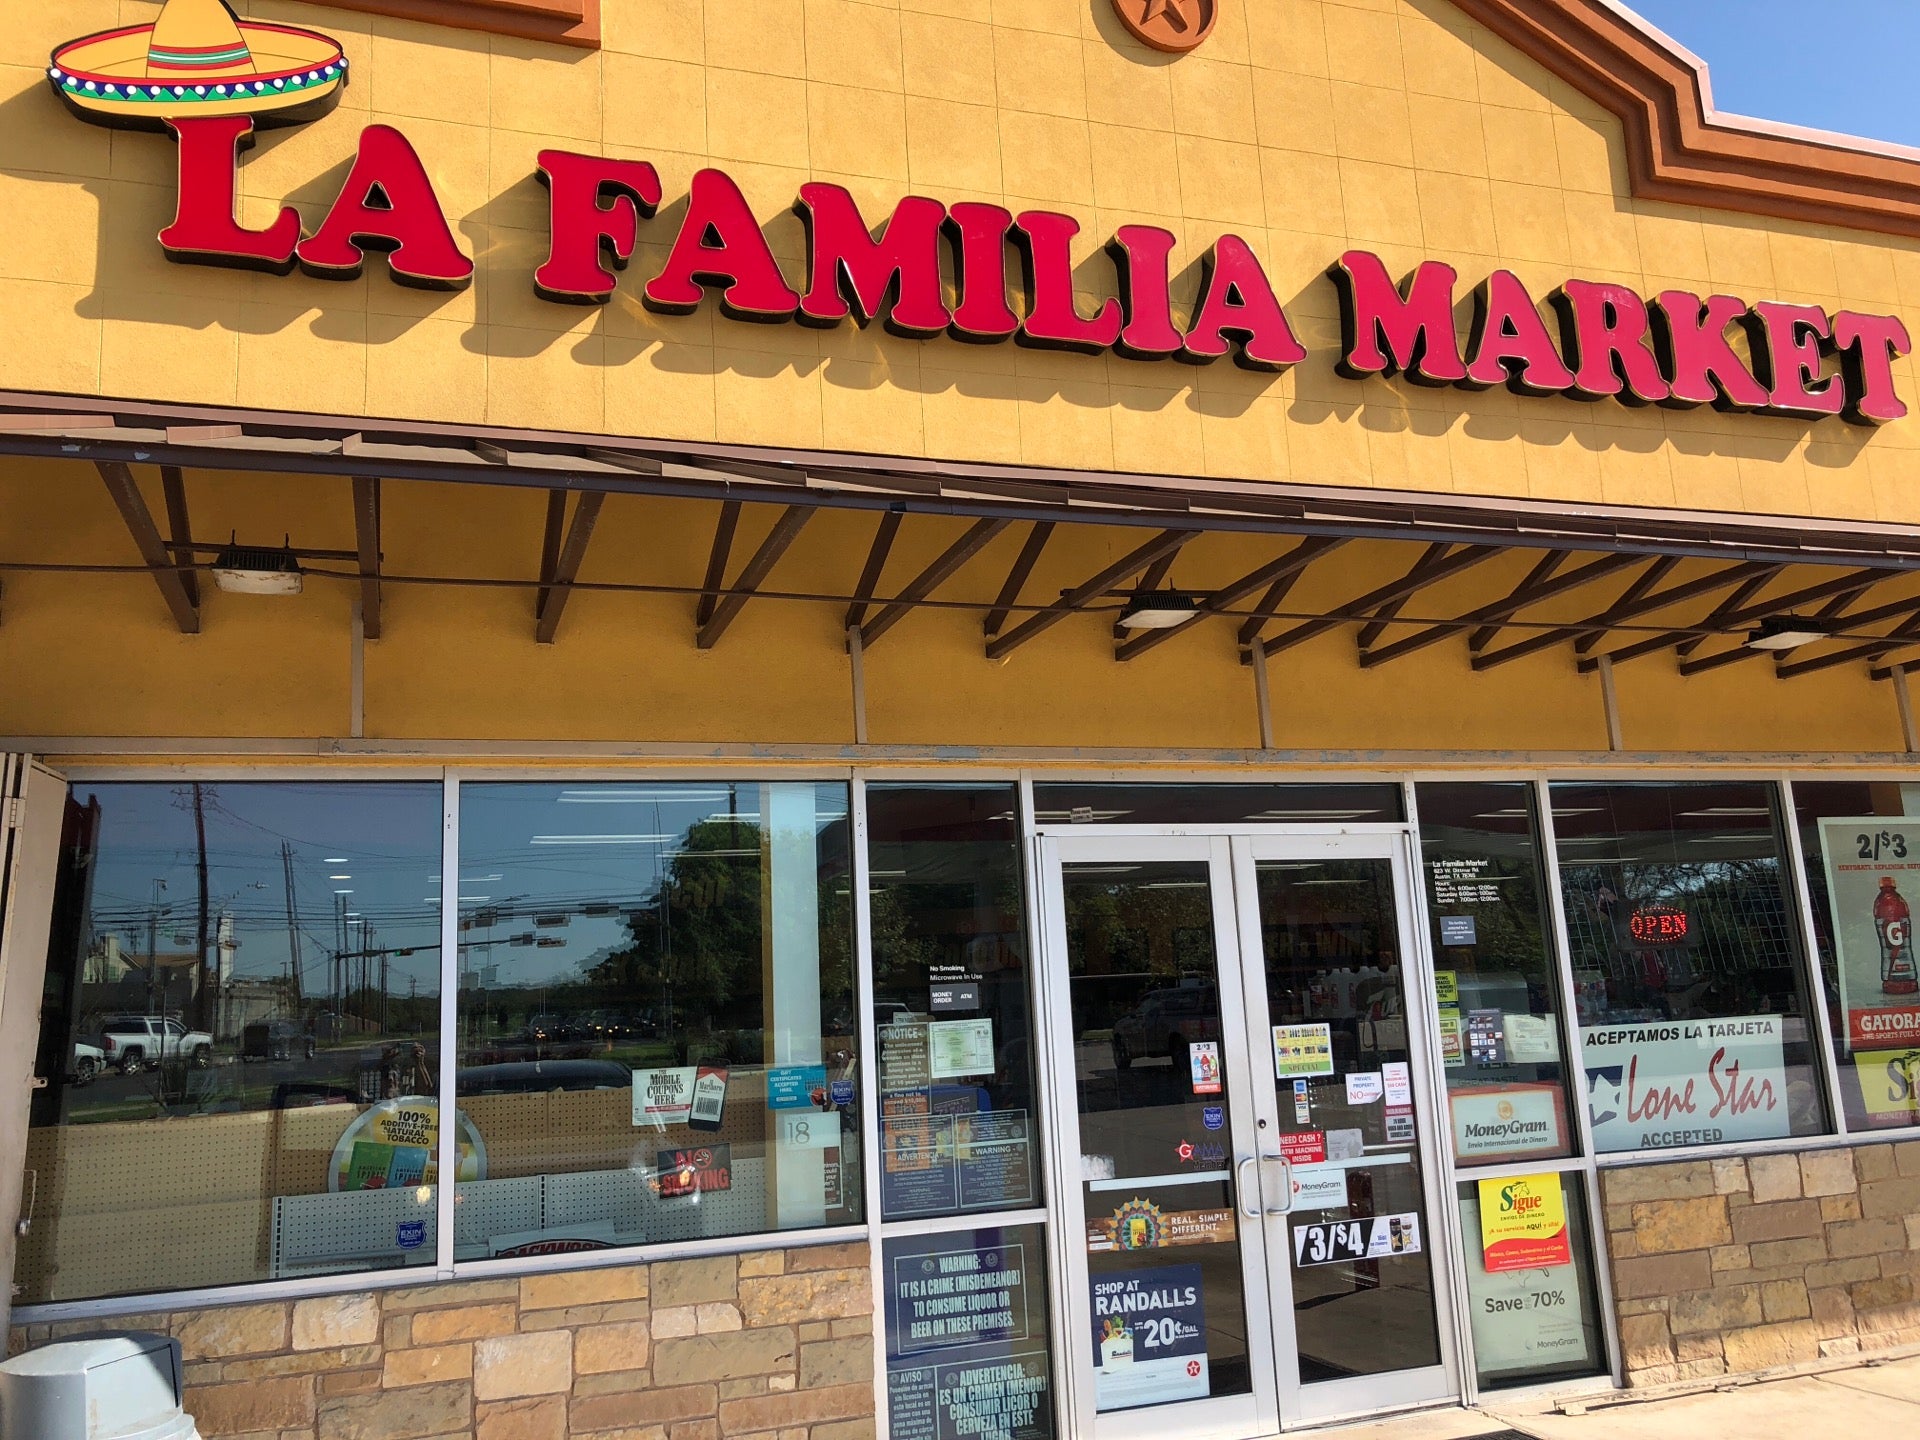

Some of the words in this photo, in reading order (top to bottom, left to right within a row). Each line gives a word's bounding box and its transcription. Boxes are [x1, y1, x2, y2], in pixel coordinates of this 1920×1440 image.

[157, 114, 475, 290] LA
[535, 149, 1308, 368] FAMILIA
[1332, 249, 1912, 425] MARKET
[1856, 830, 1908, 861] 2/$3
[1432, 860, 1441, 868] La
[1465, 859, 1488, 867] Market
[1629, 913, 1688, 936] OPEN
[1885, 921, 1904, 946] G
[929, 973, 963, 981] Microwave
[939, 964, 965, 973] Smoking
[1586, 1027, 1680, 1047] ACEPTAMOS
[1684, 1025, 1703, 1040] LA
[1707, 1020, 1774, 1038] TARJETA
[1875, 1031, 1900, 1040] SPORTS
[1899, 1030, 1914, 1038] FUEL
[649, 1073, 681, 1086] MOBILE
[1627, 1053, 1697, 1124] Lone
[1708, 1046, 1777, 1120] Star
[646, 1083, 684, 1099] COUPONS
[654, 1093, 676, 1106] HERE
[1349, 1090, 1364, 1100] NO
[397, 1111, 431, 1124] 100%
[383, 1126, 426, 1138] NATURAL
[787, 1121, 811, 1145] 18
[1465, 1119, 1549, 1139] MoneyGram
[386, 1133, 430, 1145] TOBACCO
[1280, 1135, 1297, 1145] NEED
[1298, 1133, 1316, 1144] CASH
[1484, 1137, 1521, 1148] Internacional
[1529, 1136, 1548, 1144] Dinero
[1640, 1128, 1724, 1148] ACCEPTED
[1294, 1145, 1323, 1154] MACHINE
[1291, 1154, 1313, 1163] INSIDE
[1301, 1181, 1341, 1191] MoneyGram
[1500, 1185, 1542, 1215] Sigue
[1171, 1215, 1196, 1225] REAL.
[1198, 1212, 1232, 1223] SIMPLE.
[400, 1229, 422, 1239] EXIN
[1171, 1222, 1220, 1234] DIFFERENT.
[1308, 1222, 1364, 1262] 3/$4
[938, 1253, 982, 1274] WARNING:
[900, 1281, 909, 1299] IT
[910, 1280, 920, 1298] IS
[920, 1279, 927, 1297] A
[927, 1276, 955, 1296] CRIME
[955, 1269, 1021, 1292] (MISDEMEANOR)
[1094, 1281, 1125, 1296] SHOP
[1126, 1279, 1140, 1292] AT
[913, 1300, 925, 1318] TO
[926, 1295, 967, 1316] CONSUME
[967, 1292, 998, 1313] LIQUOR
[998, 1290, 1011, 1308] OR
[1095, 1286, 1197, 1316] RANDALLS
[1485, 1297, 1524, 1314] Save
[1530, 1289, 1566, 1309] 70%
[910, 1321, 933, 1339] BEER
[932, 1318, 945, 1336] ON
[945, 1315, 972, 1335] THESE
[972, 1310, 1016, 1332] PREMISES.
[1536, 1337, 1579, 1349] MoneyGram
[900, 1370, 922, 1385] AVISO
[959, 1362, 1026, 1387] ADVERTENCIA:
[939, 1388, 951, 1406] ES
[952, 1386, 967, 1404] UN
[968, 1381, 1005, 1402] CRIMEN
[1006, 1375, 1047, 1397] (MENOR)
[949, 1397, 1001, 1421] CONSUMIR
[1002, 1393, 1031, 1413] LICOR
[1031, 1392, 1039, 1409] O
[955, 1414, 998, 1436] CERVEZA
[998, 1412, 1012, 1430] EN
[1011, 1409, 1035, 1429] ESTE
